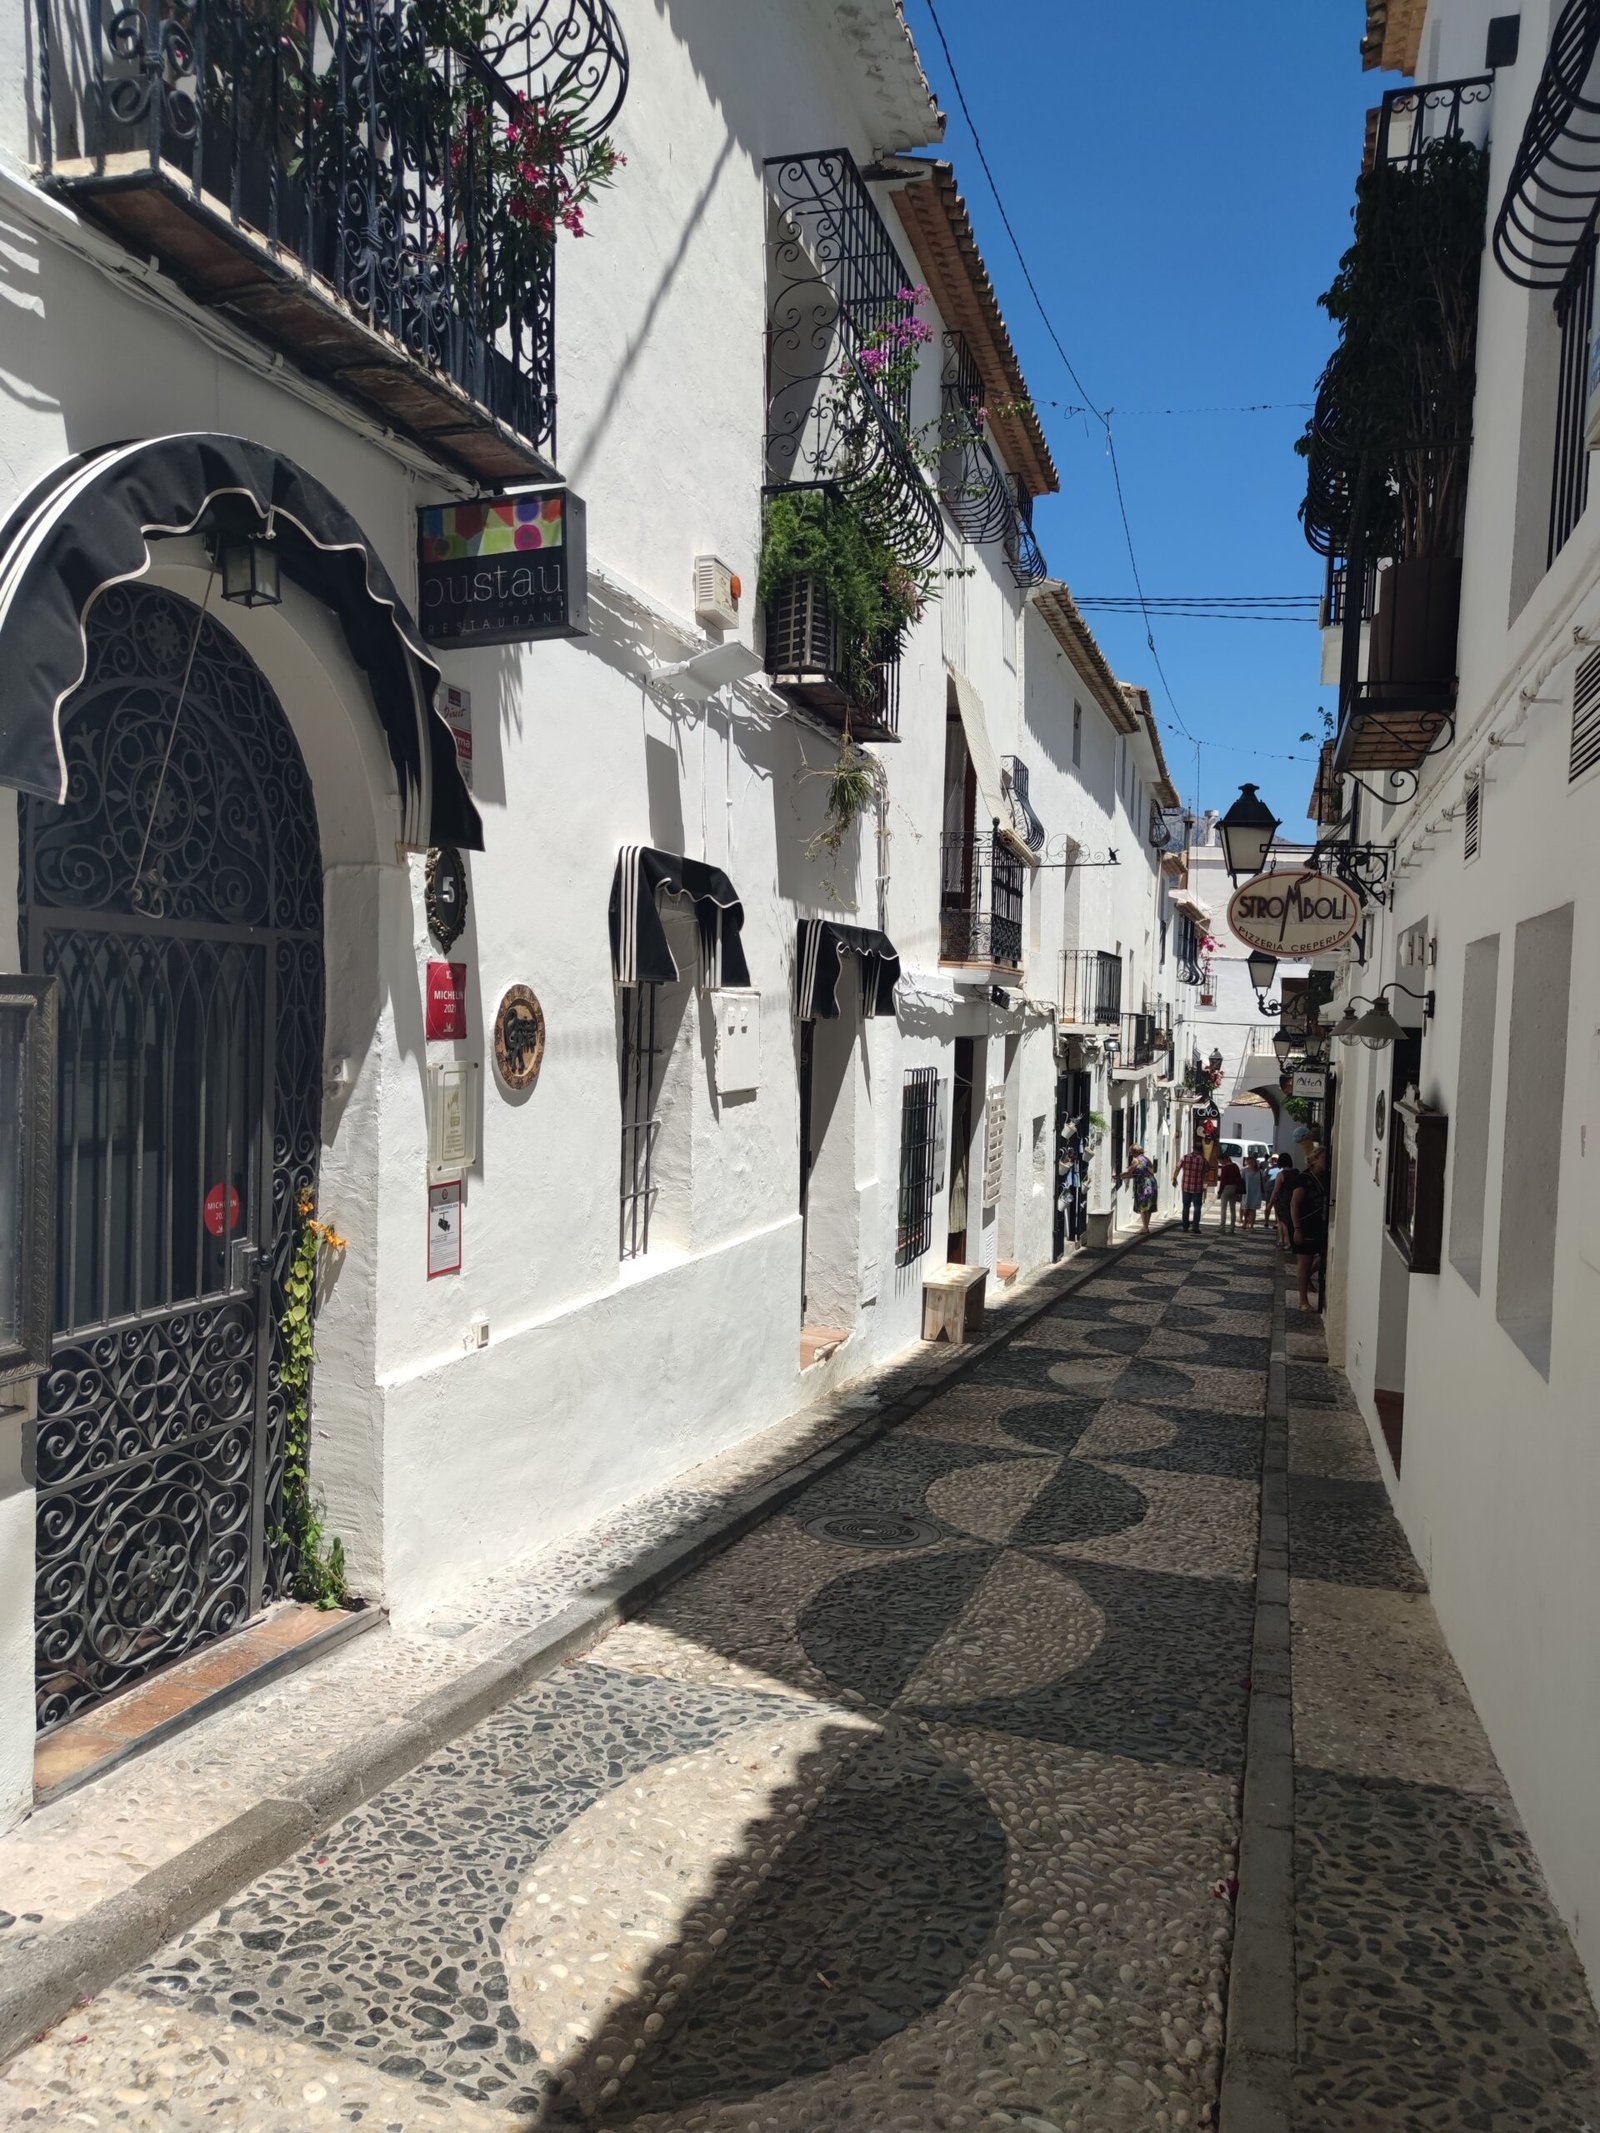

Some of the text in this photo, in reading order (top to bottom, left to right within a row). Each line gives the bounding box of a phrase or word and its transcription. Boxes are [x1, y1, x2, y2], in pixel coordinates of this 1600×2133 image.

[428, 611, 564, 634] RESTAURANT
[442, 876, 455, 903] 5
[1237, 884, 1347, 942] STROMBOLI
[1238, 926, 1345, 952] PIZZERIA CREPERIA
[434, 990, 464, 1000] MICHELIN
[207, 1200, 237, 1210] MICHIN
